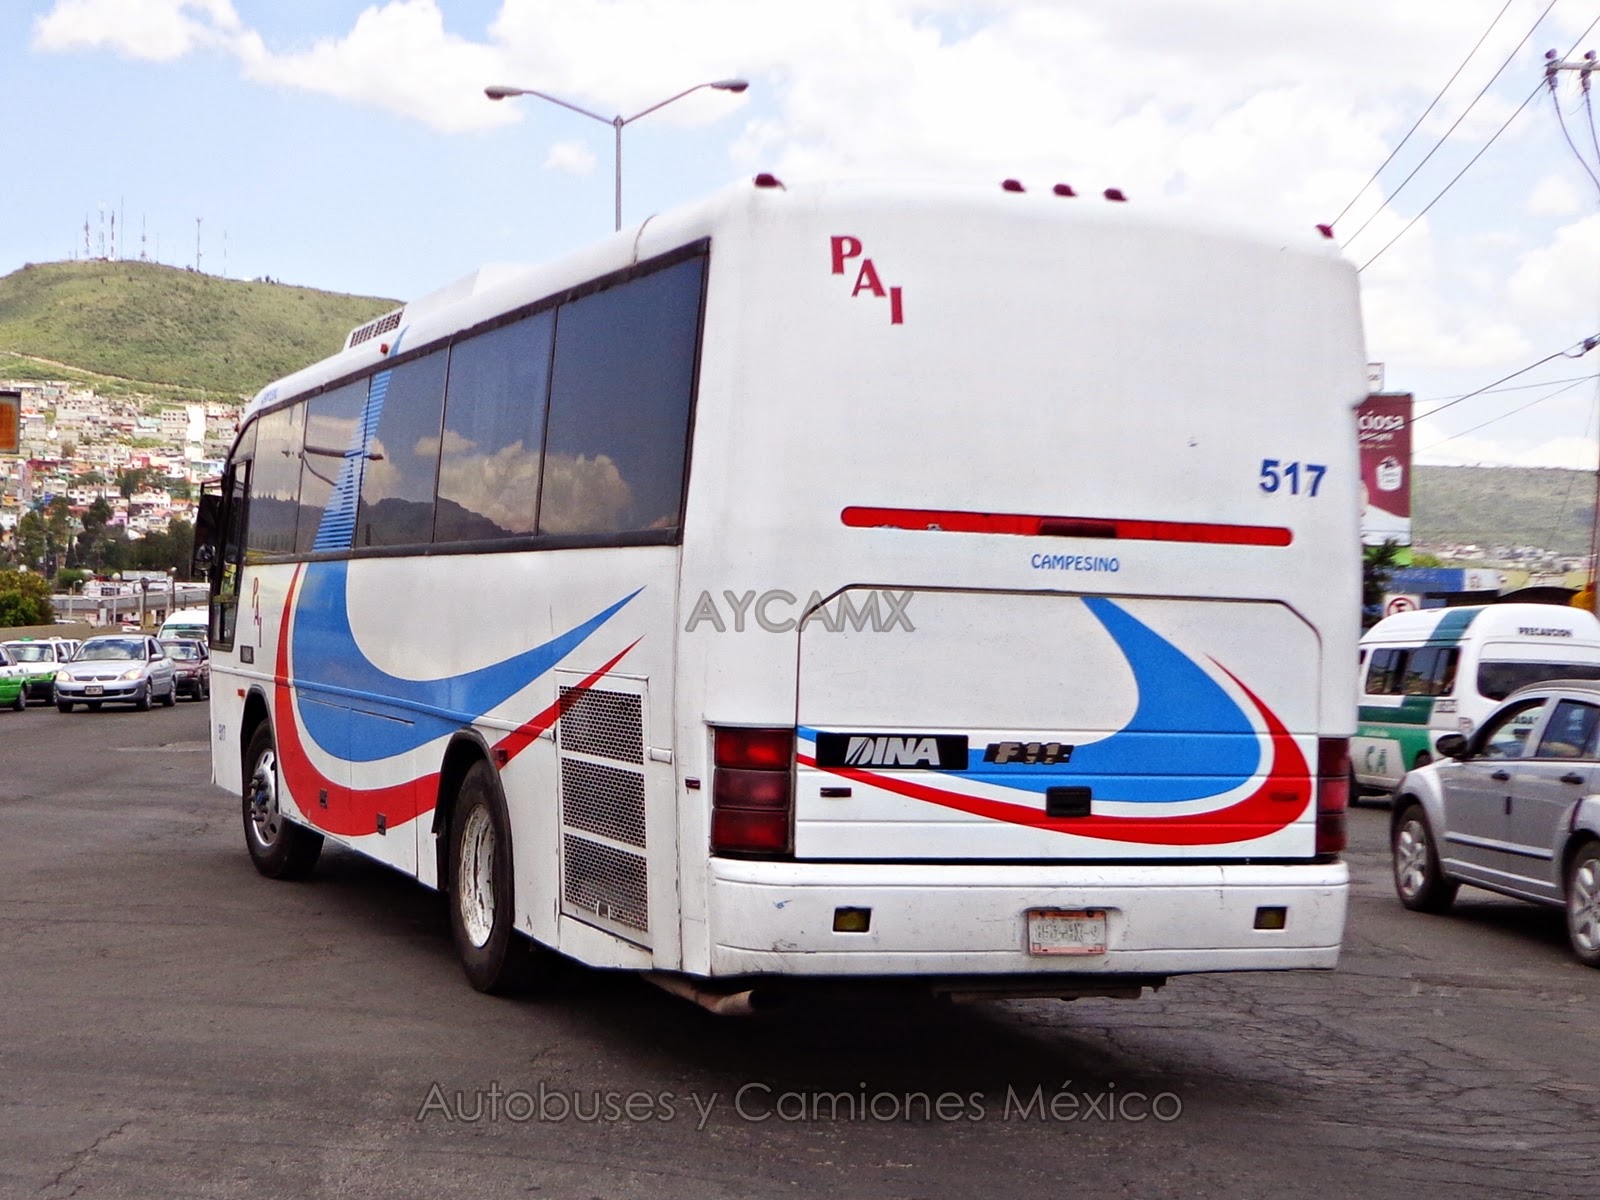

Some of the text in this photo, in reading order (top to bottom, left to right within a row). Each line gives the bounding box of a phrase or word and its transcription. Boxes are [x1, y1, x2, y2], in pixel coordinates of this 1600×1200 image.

[829, 235, 904, 325] PAI
[1259, 459, 1327, 497] 517
[1031, 553, 1120, 573] CAMPESINO
[845, 737, 940, 766] DINA
